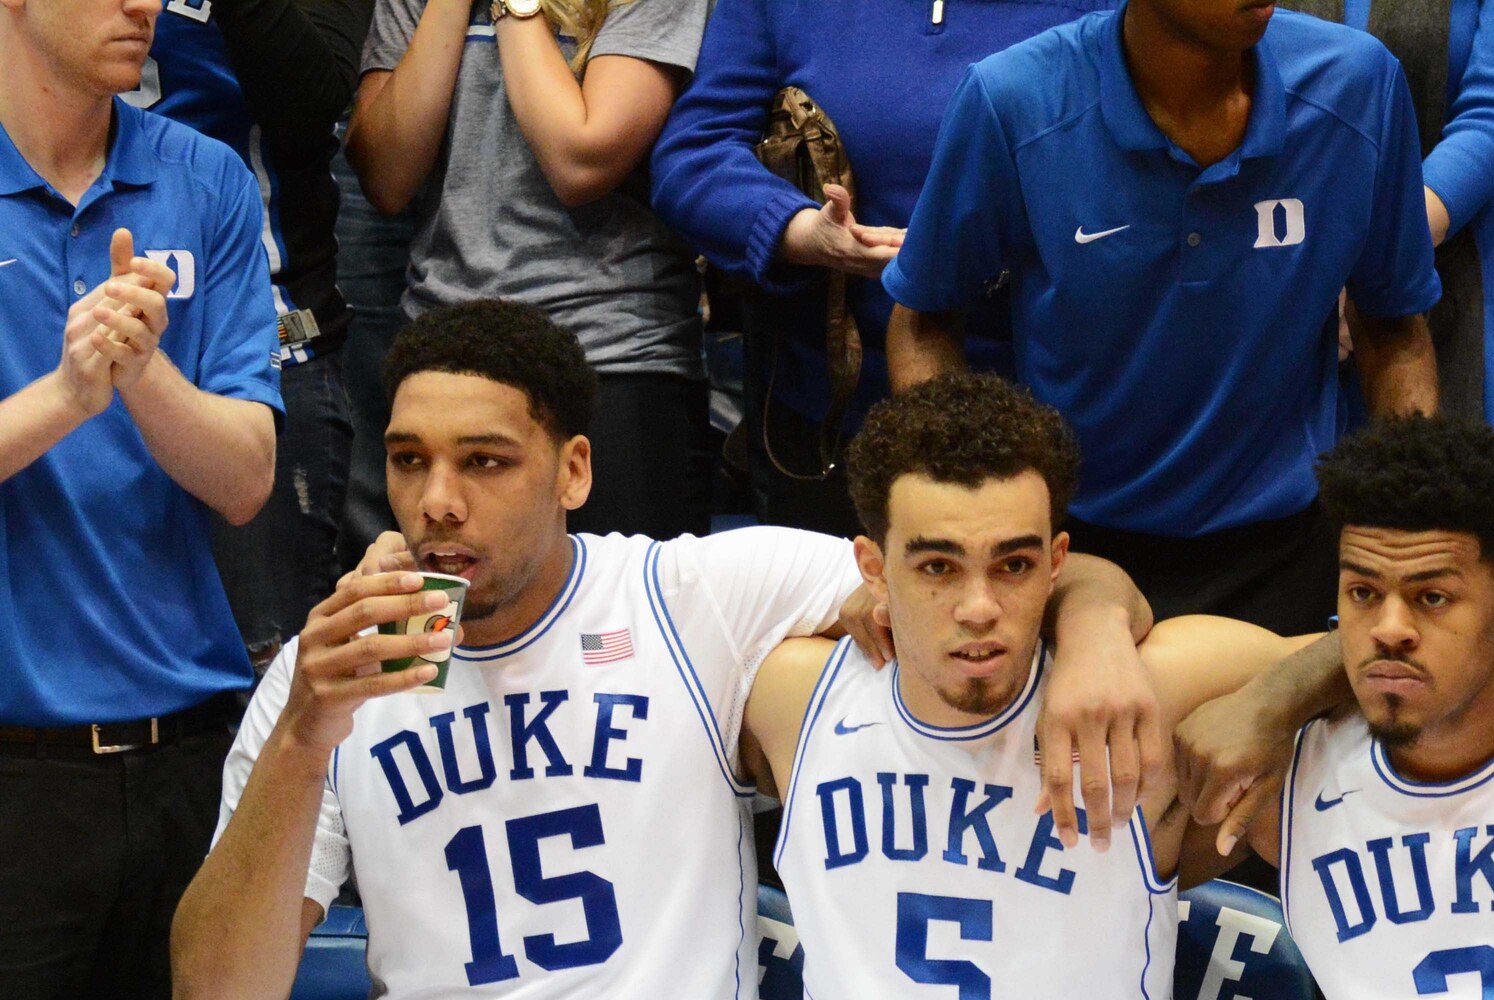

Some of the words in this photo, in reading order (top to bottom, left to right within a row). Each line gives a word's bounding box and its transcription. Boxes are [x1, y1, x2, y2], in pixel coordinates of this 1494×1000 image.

[1253, 198, 1306, 248] D
[369, 689, 650, 826] DUKE
[444, 803, 623, 986] 15
[816, 772, 1089, 895] DUKE
